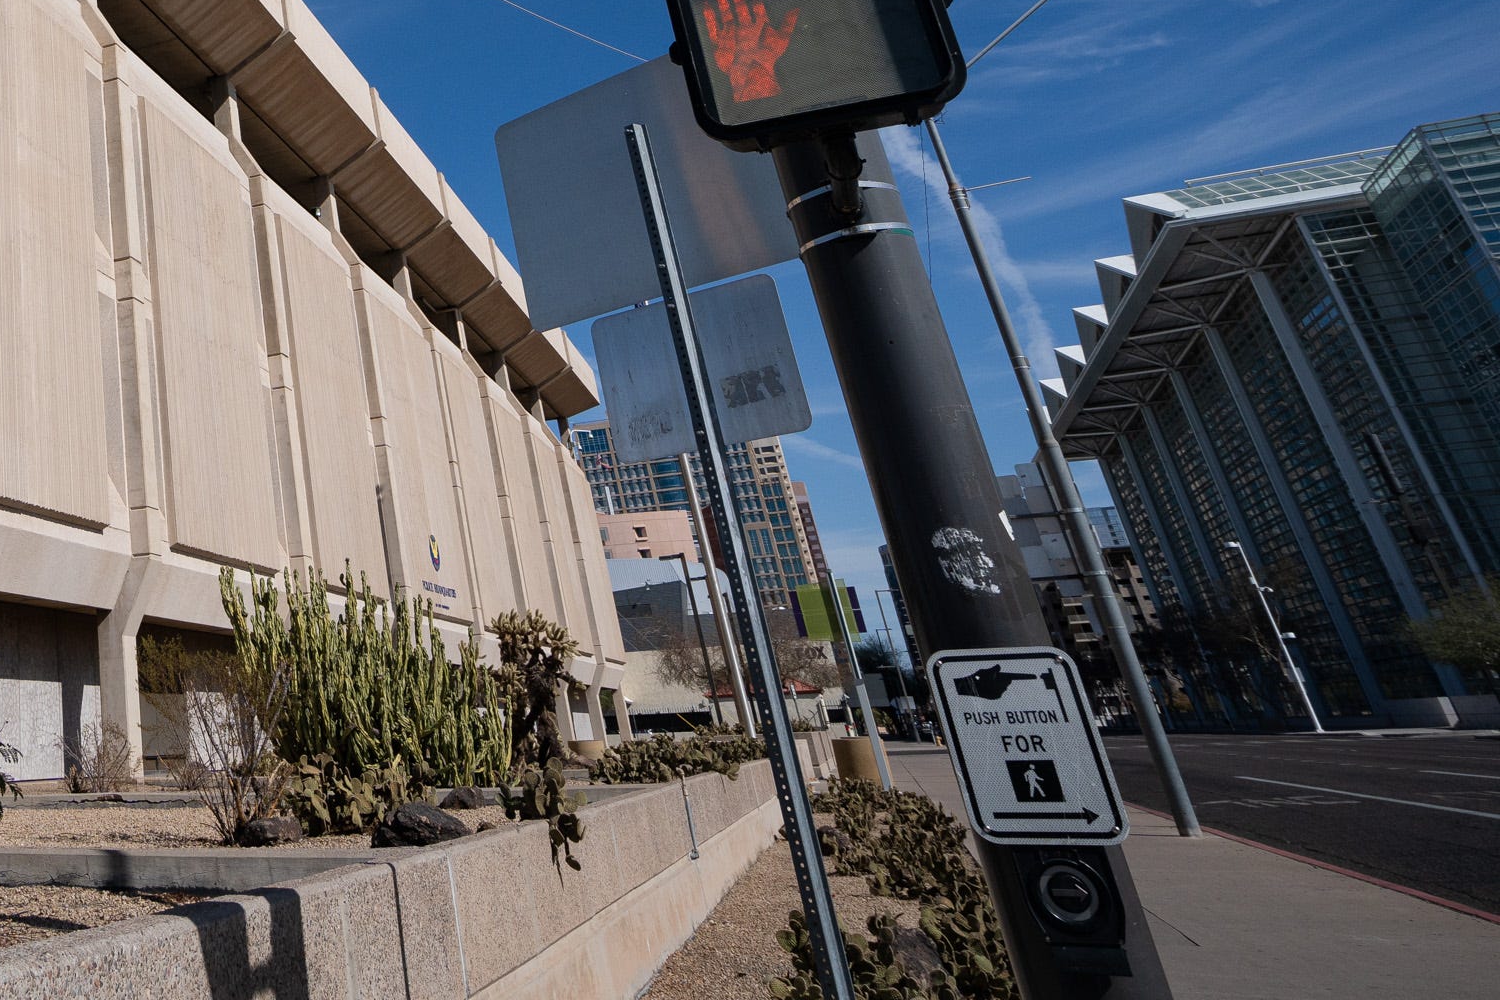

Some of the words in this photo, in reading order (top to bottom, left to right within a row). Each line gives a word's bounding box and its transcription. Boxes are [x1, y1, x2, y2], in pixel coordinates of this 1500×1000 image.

[963, 711, 1001, 725] PUSH
[1005, 710, 1059, 724] BUTTON
[1001, 735, 1047, 753] FOR
